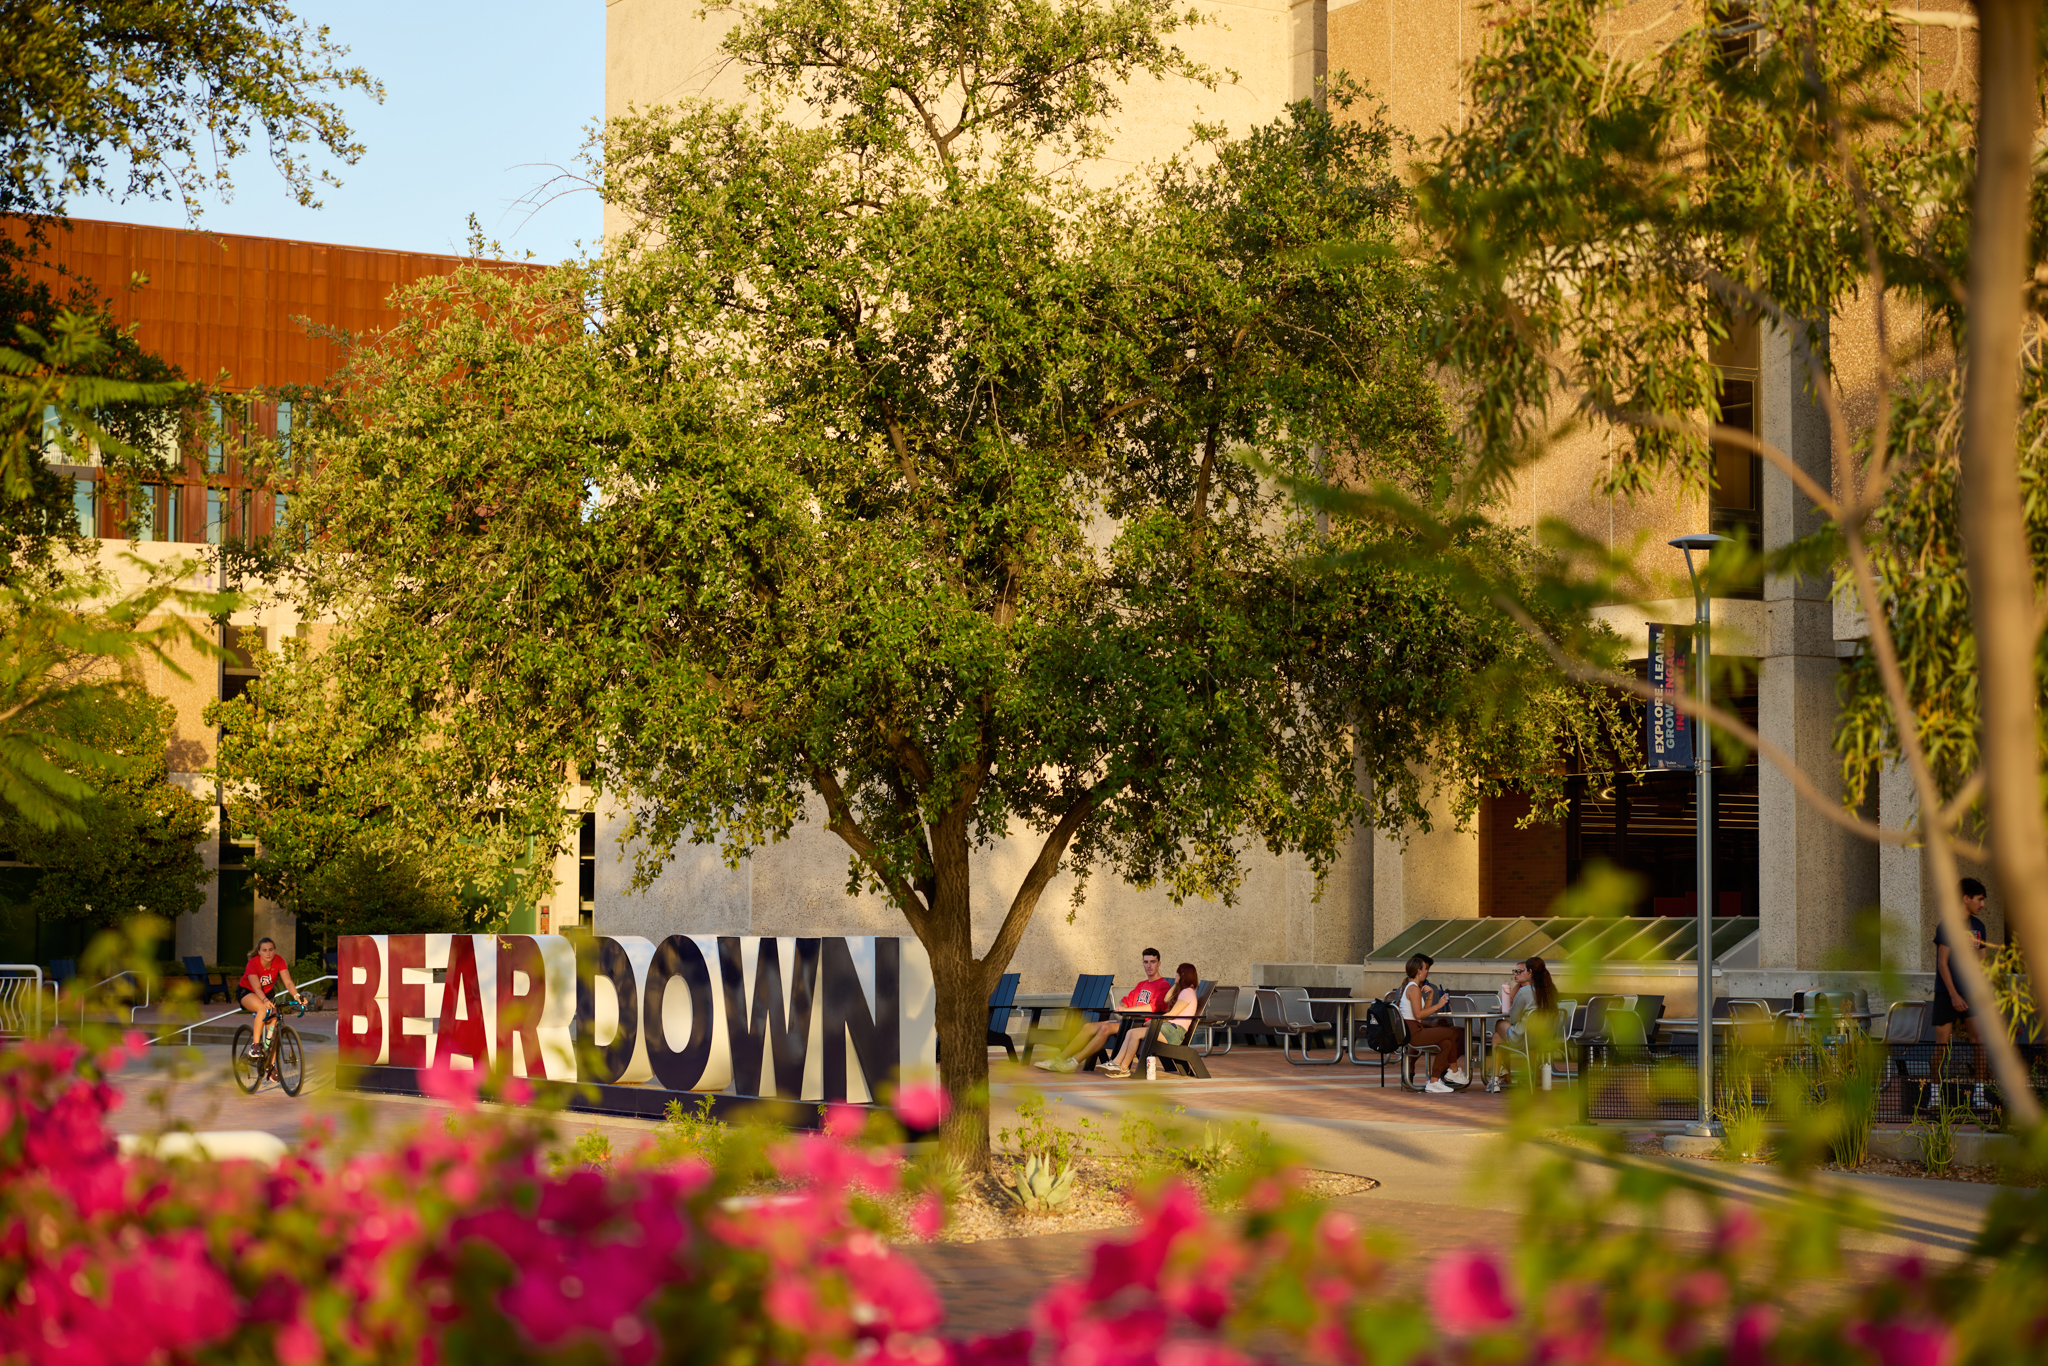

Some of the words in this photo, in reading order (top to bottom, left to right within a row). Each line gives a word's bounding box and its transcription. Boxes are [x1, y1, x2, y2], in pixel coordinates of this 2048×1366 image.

[1654, 628, 1666, 680] LEARN.
[1665, 635, 1676, 697] ENGAGE.
[1654, 684, 1665, 754] EXPLORE.
[1665, 701, 1675, 749] GROW.
[337, 934, 550, 1080] BEAR
[576, 934, 900, 1104] DOWN
